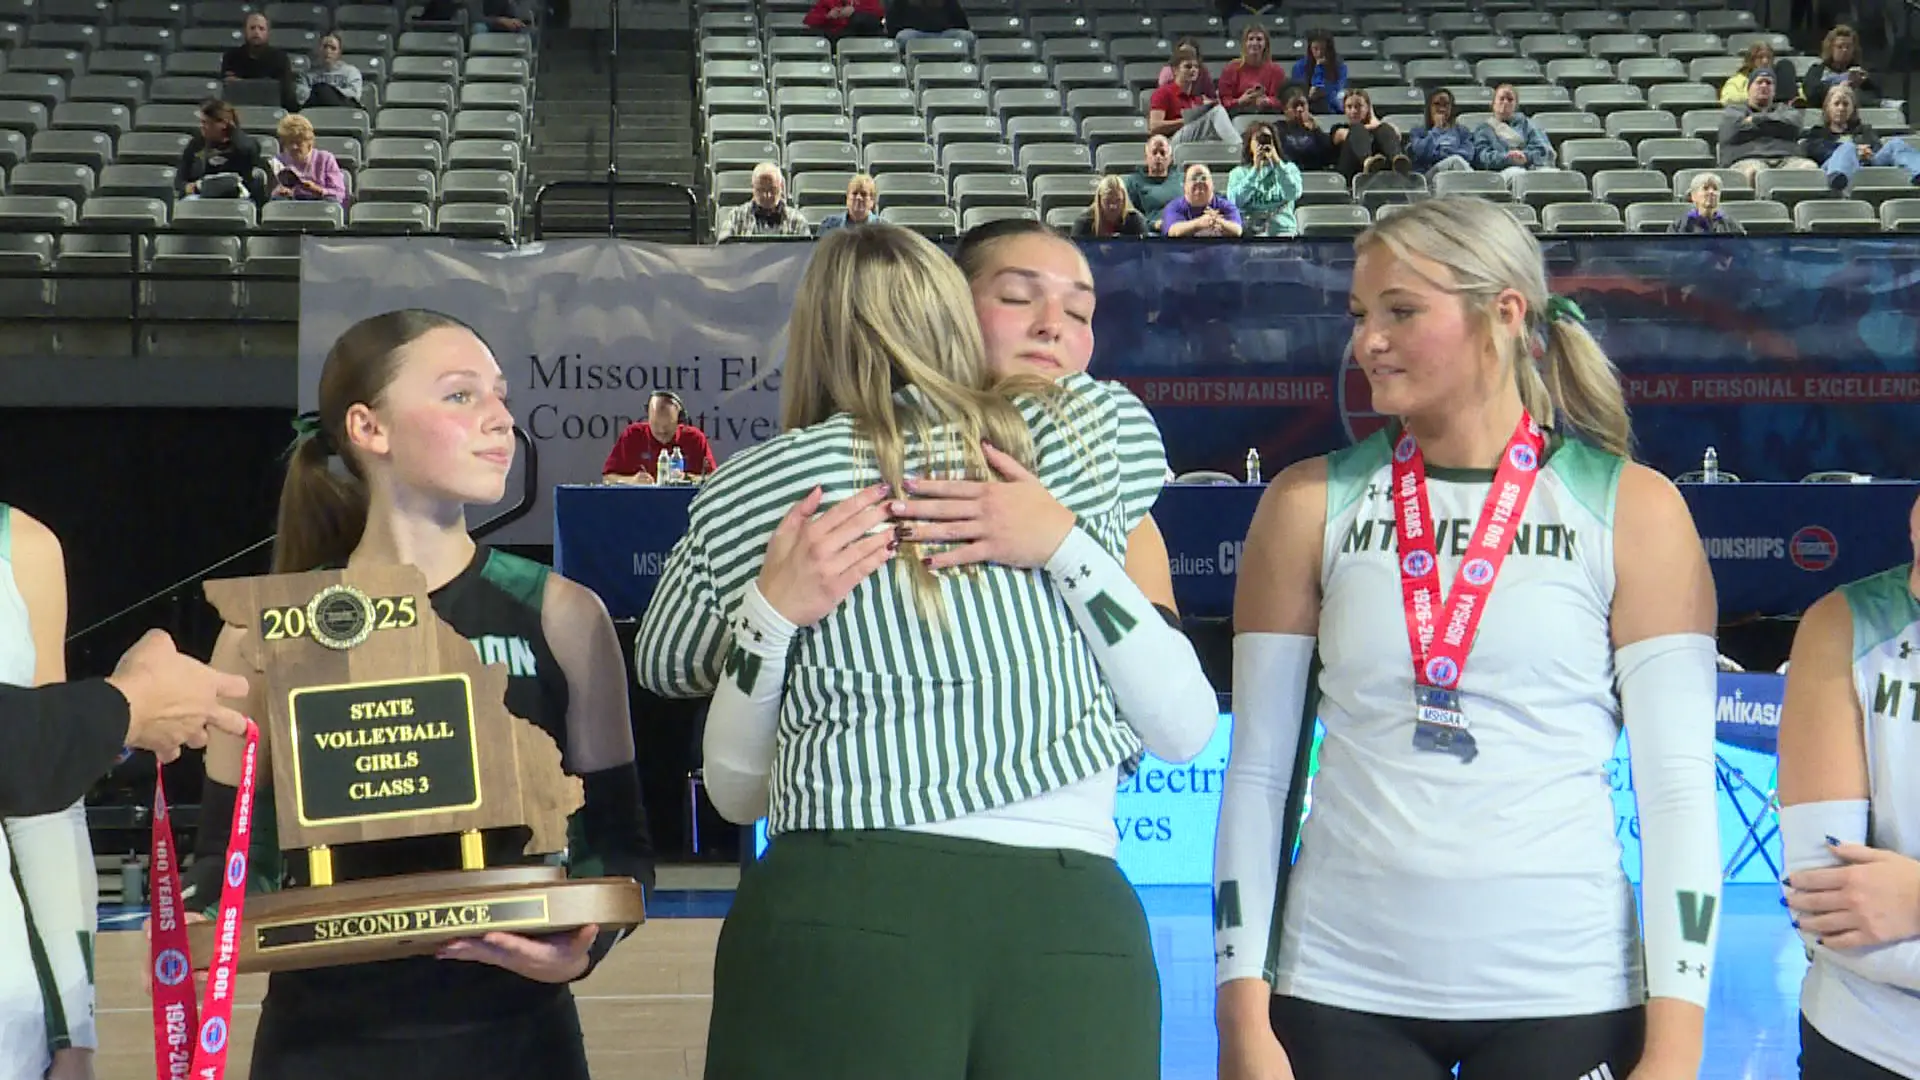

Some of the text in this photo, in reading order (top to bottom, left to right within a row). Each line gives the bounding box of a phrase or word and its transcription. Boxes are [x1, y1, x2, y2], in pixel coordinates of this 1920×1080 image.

[528, 354, 701, 391] Missouri
[1144, 381, 1329, 400] SPORTSMANSHIP.
[1692, 379, 1796, 398] PERSONAL
[1400, 471, 1424, 540] 100 YEARS
[1482, 482, 1521, 550] 100 YEARS
[1702, 537, 1784, 559] IONSHIPS
[263, 596, 416, 640] 20 25
[350, 698, 414, 720] STATE
[1423, 708, 1461, 726] MSHSAA
[315, 722, 454, 750] VOLLEYBALL
[355, 751, 419, 773] GIRLS
[349, 776, 430, 800] CLASS 3
[157, 840, 176, 931] 100 YEARS
[315, 904, 491, 940] SECOND PLACE
[213, 908, 237, 1001] 100 YEARS
